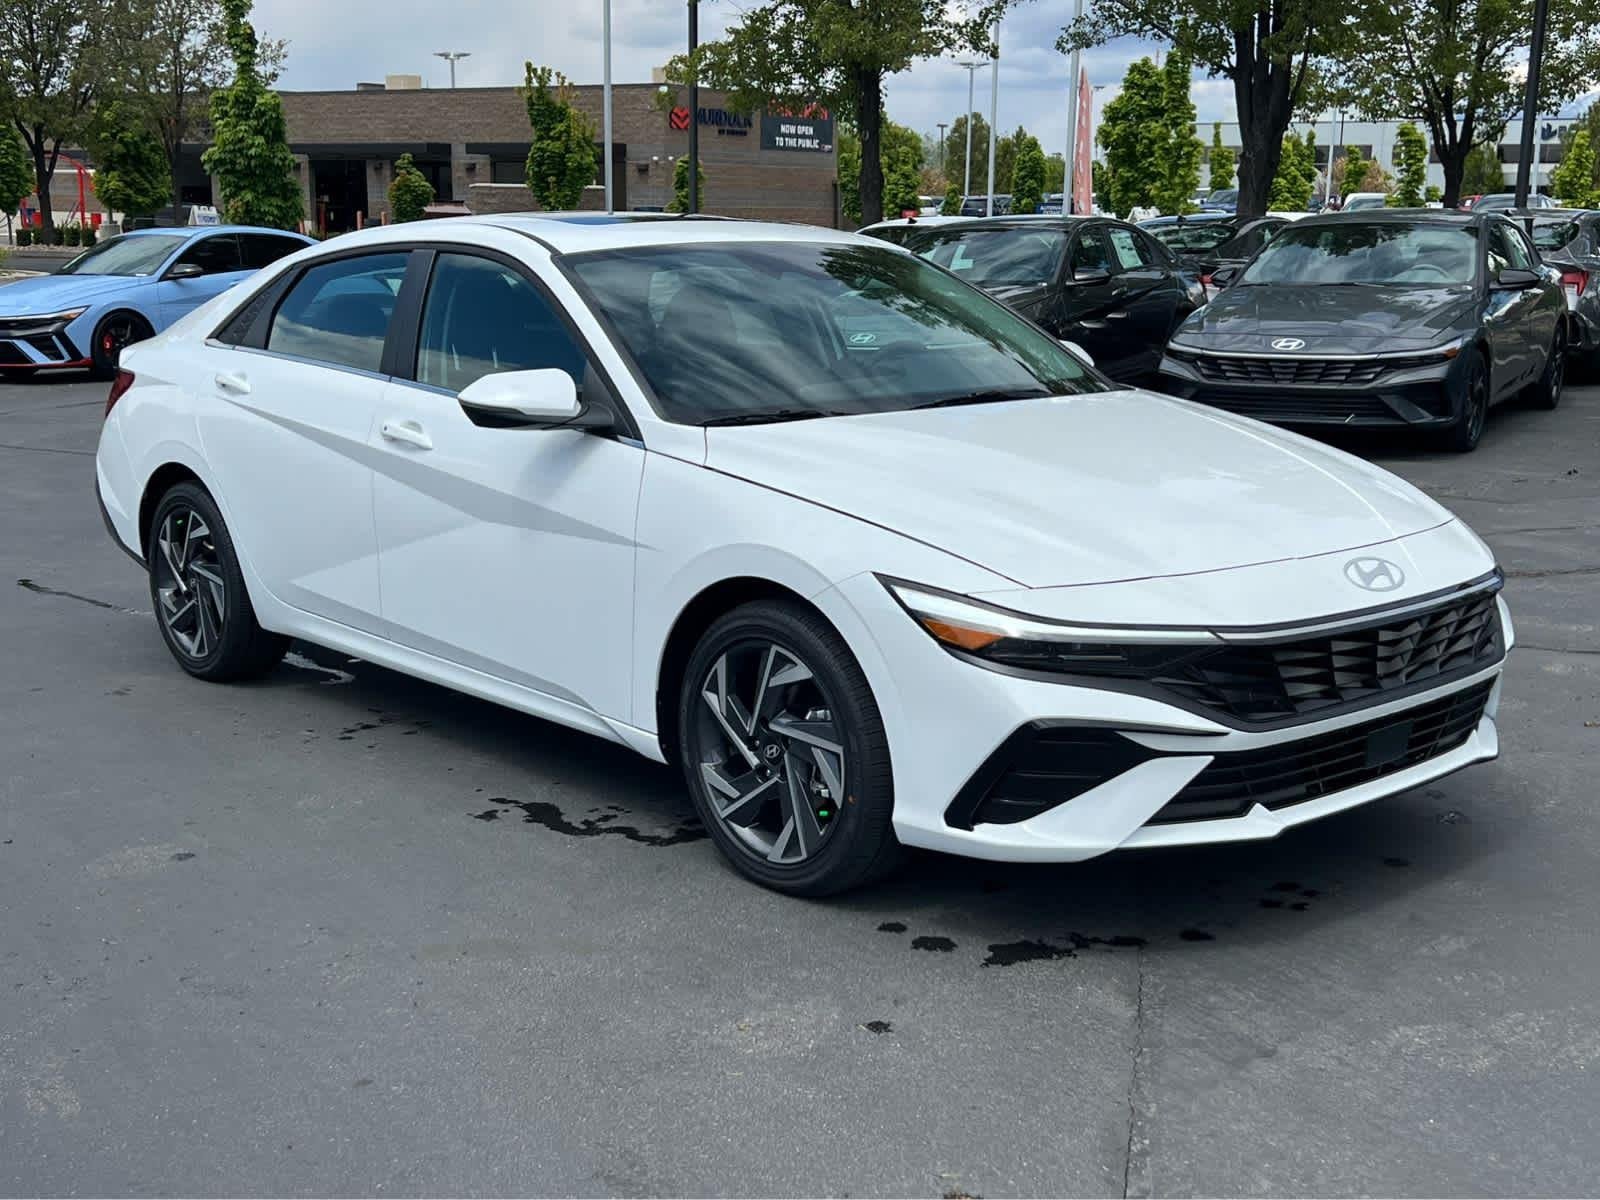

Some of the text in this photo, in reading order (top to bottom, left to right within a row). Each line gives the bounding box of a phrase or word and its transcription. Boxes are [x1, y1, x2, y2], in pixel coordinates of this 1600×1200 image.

[780, 124, 814, 135] NOW OPEN
[775, 136, 784, 146] TO
[785, 137, 797, 148] THE
[798, 138, 819, 149] PUBLIC
